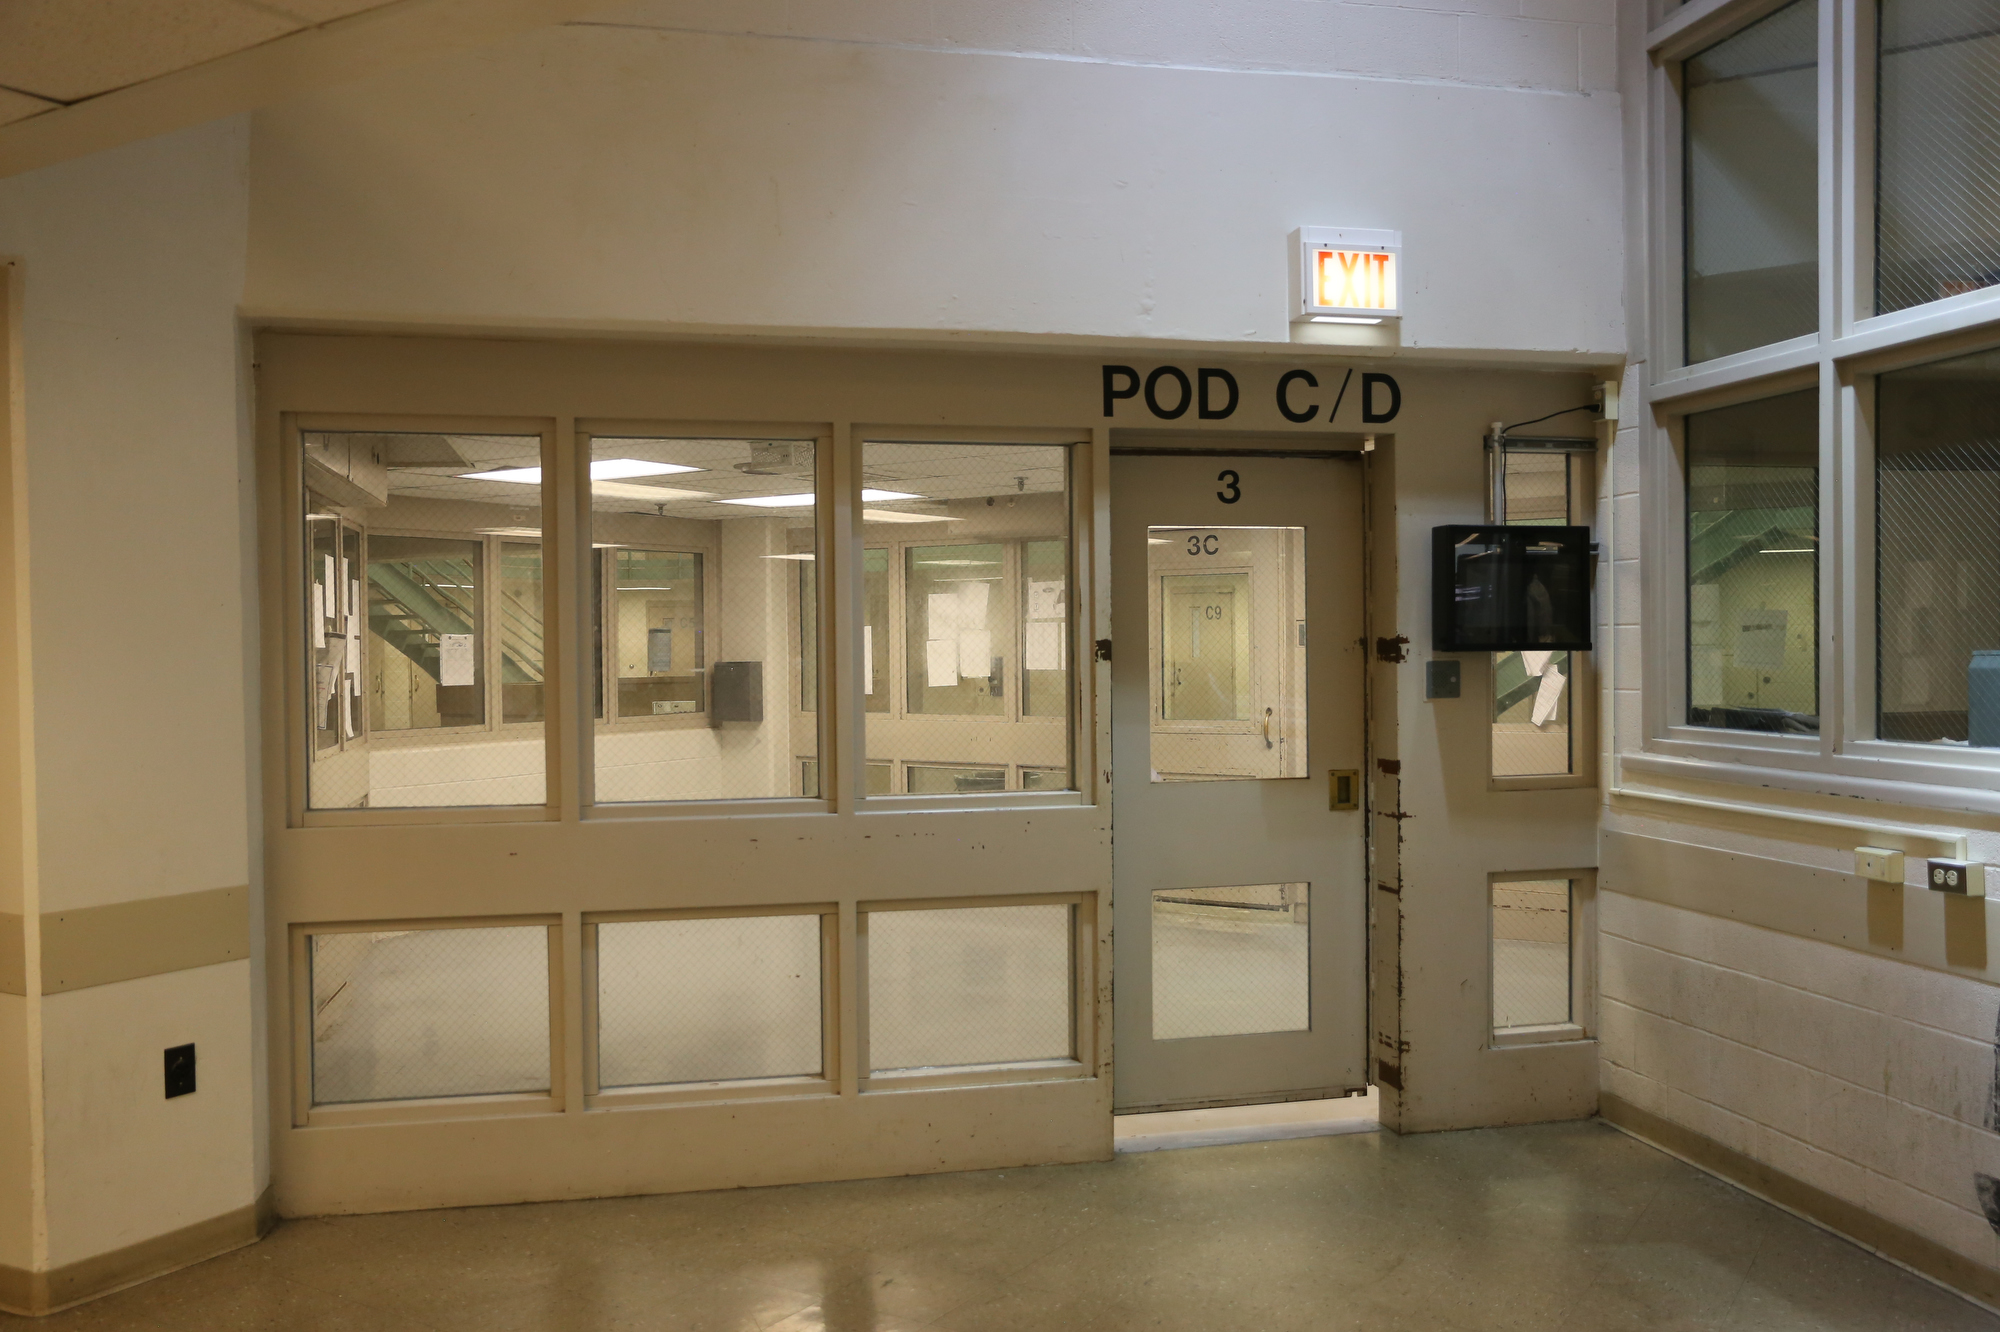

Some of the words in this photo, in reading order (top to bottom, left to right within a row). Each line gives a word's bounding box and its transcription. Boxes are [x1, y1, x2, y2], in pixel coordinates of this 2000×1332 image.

[1318, 251, 1389, 309] EXIT
[1101, 364, 1240, 421] POD
[1275, 367, 1402, 425] C/D
[1216, 469, 1242, 505] 3
[1187, 534, 1219, 556] 3C
[1205, 605, 1223, 620] C9
